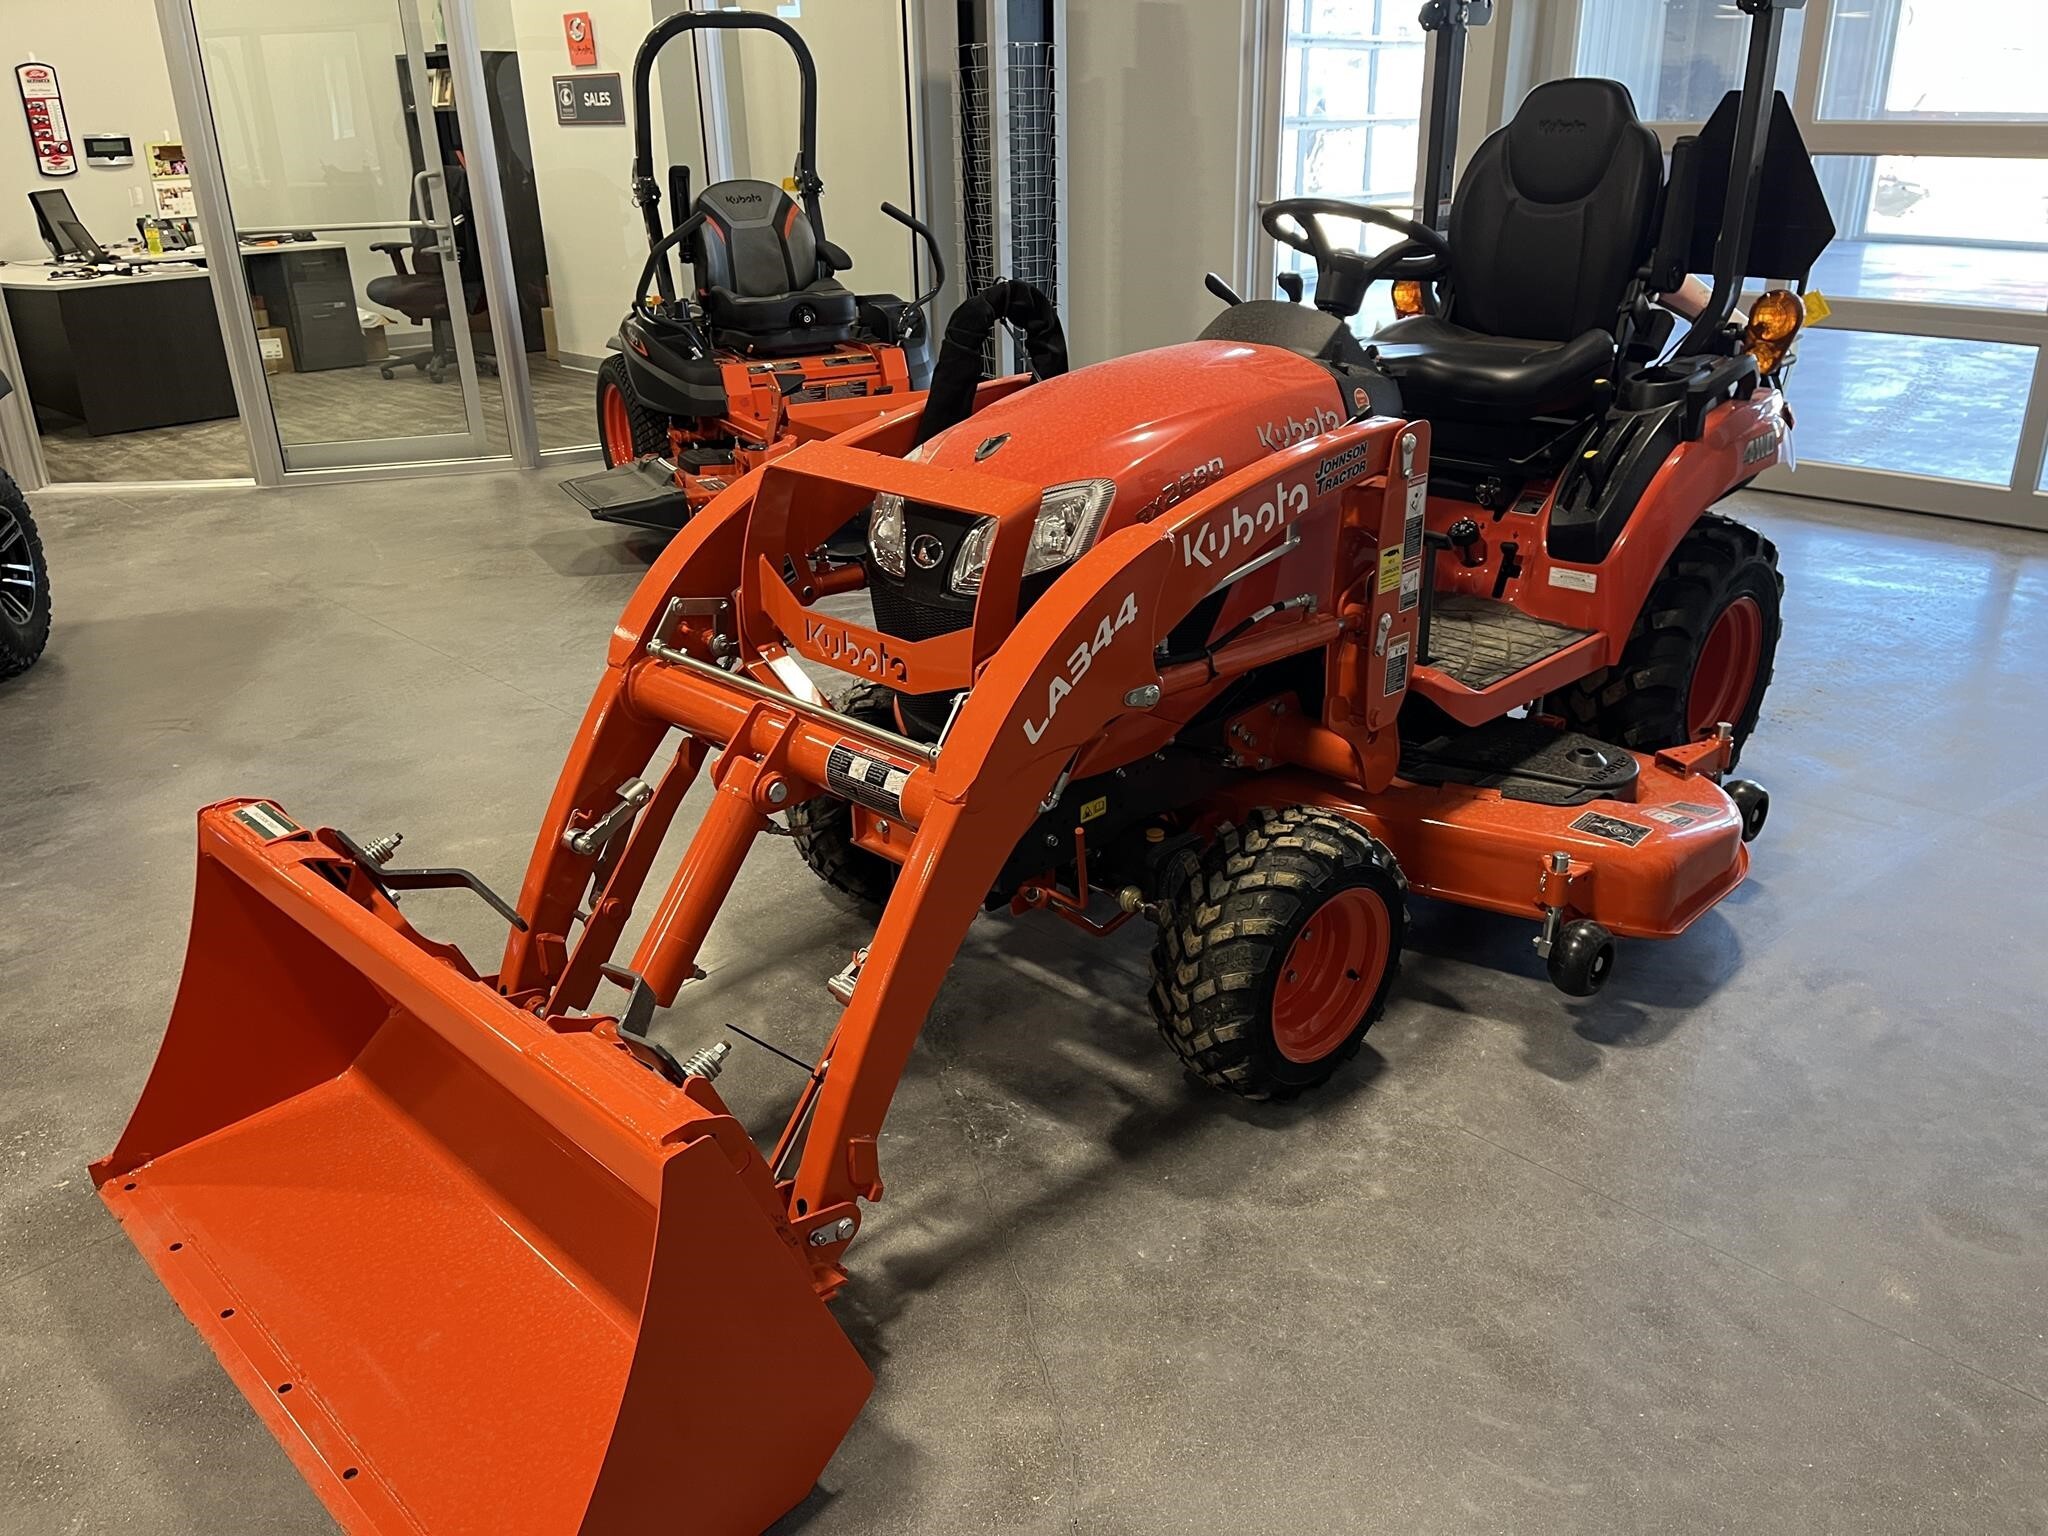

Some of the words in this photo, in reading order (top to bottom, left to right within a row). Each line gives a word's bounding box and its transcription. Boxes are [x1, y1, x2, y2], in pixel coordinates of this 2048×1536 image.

[583, 91, 611, 107] SALES
[725, 193, 762, 205] Kubota
[1256, 406, 1341, 450] Kubota
[1314, 442, 1368, 479] JOHNSON
[1743, 431, 1776, 464] 4WD
[1315, 460, 1367, 497] TRACTOR
[1183, 481, 1309, 568] Kubota
[805, 618, 908, 685] Kubota
[1023, 592, 1138, 745] LA344
